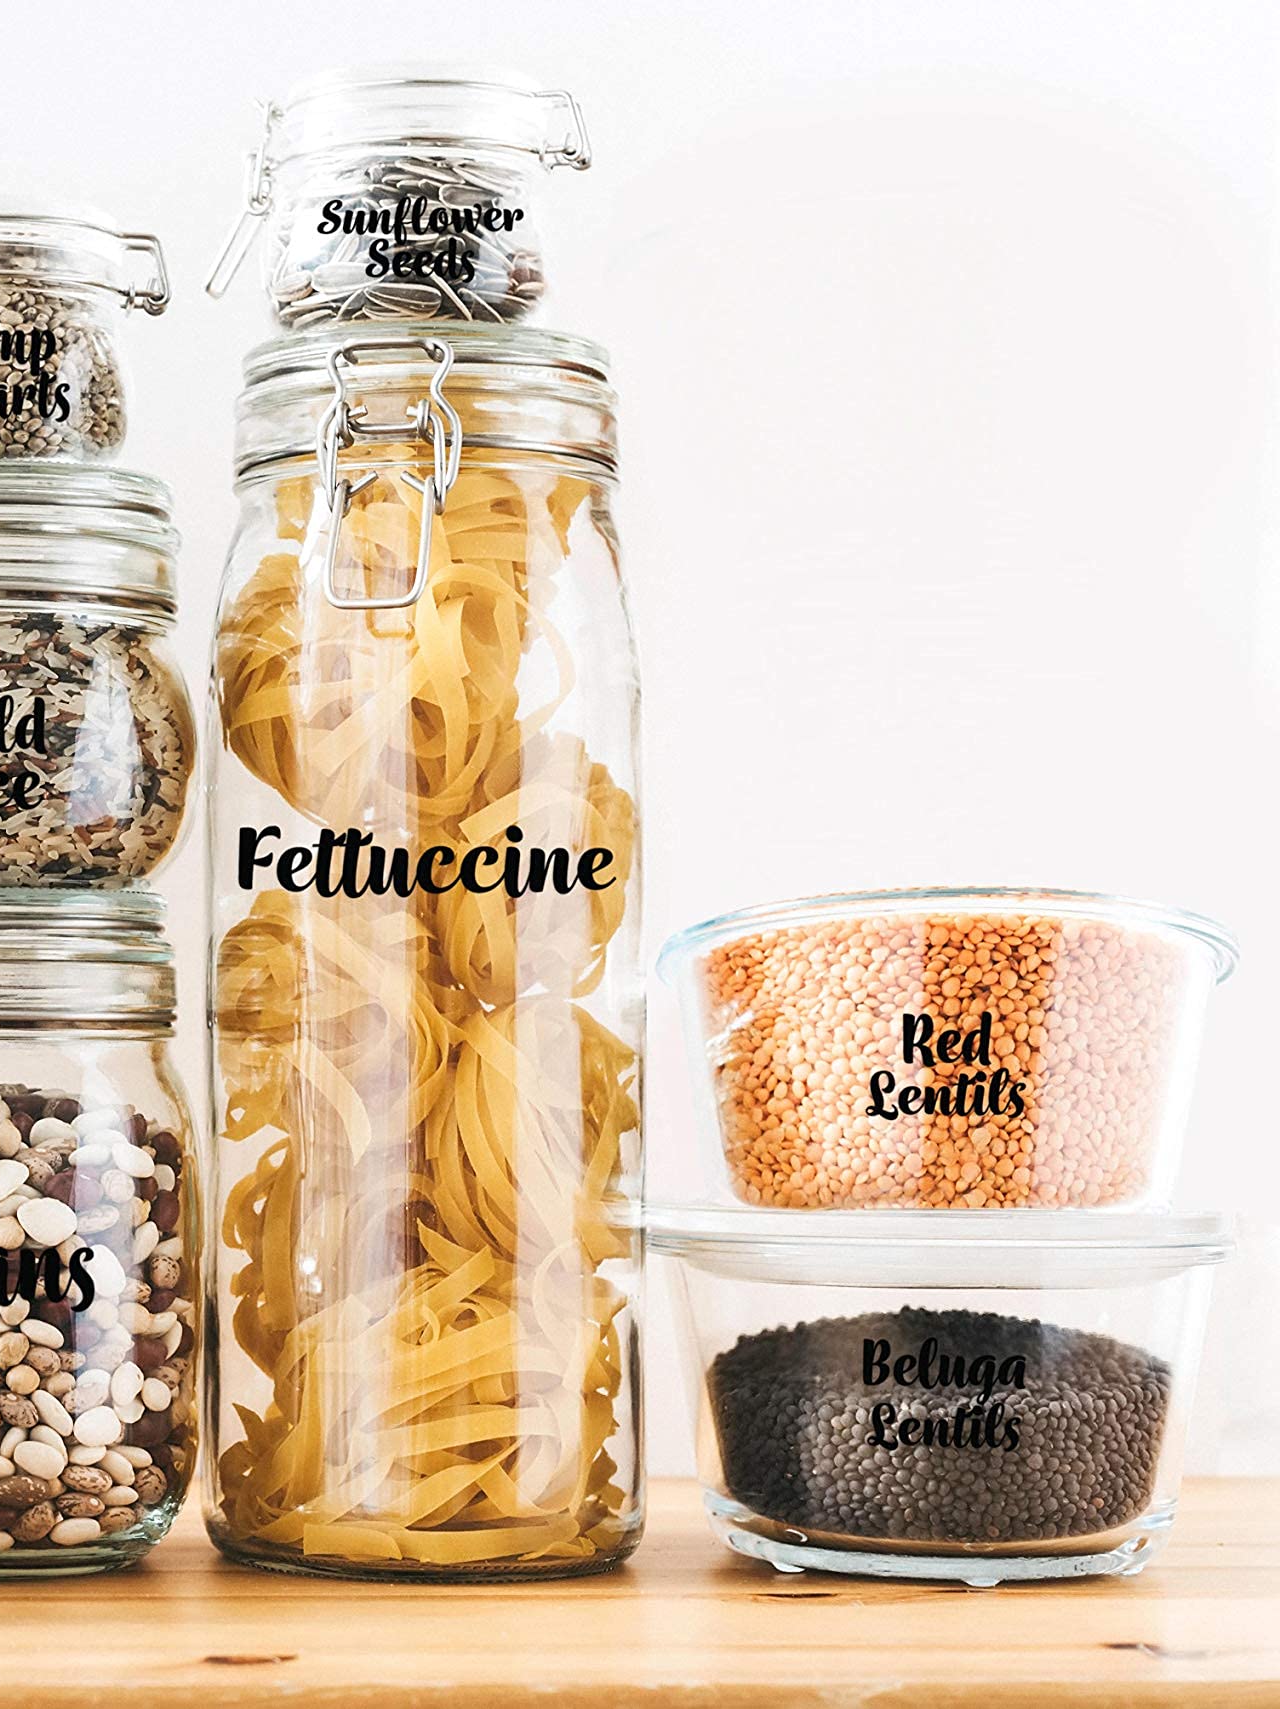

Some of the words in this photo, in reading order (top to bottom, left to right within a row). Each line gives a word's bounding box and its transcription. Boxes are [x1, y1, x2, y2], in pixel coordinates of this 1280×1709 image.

[317, 197, 524, 244] Sunflower
[365, 238, 476, 283] Seeds
[237, 825, 617, 899] Fettuccine
[902, 1013, 992, 1067] Red
[865, 1070, 1027, 1121] Lentils
[861, 1338, 1027, 1402] Beluga
[867, 1402, 1022, 1453] Lentils
